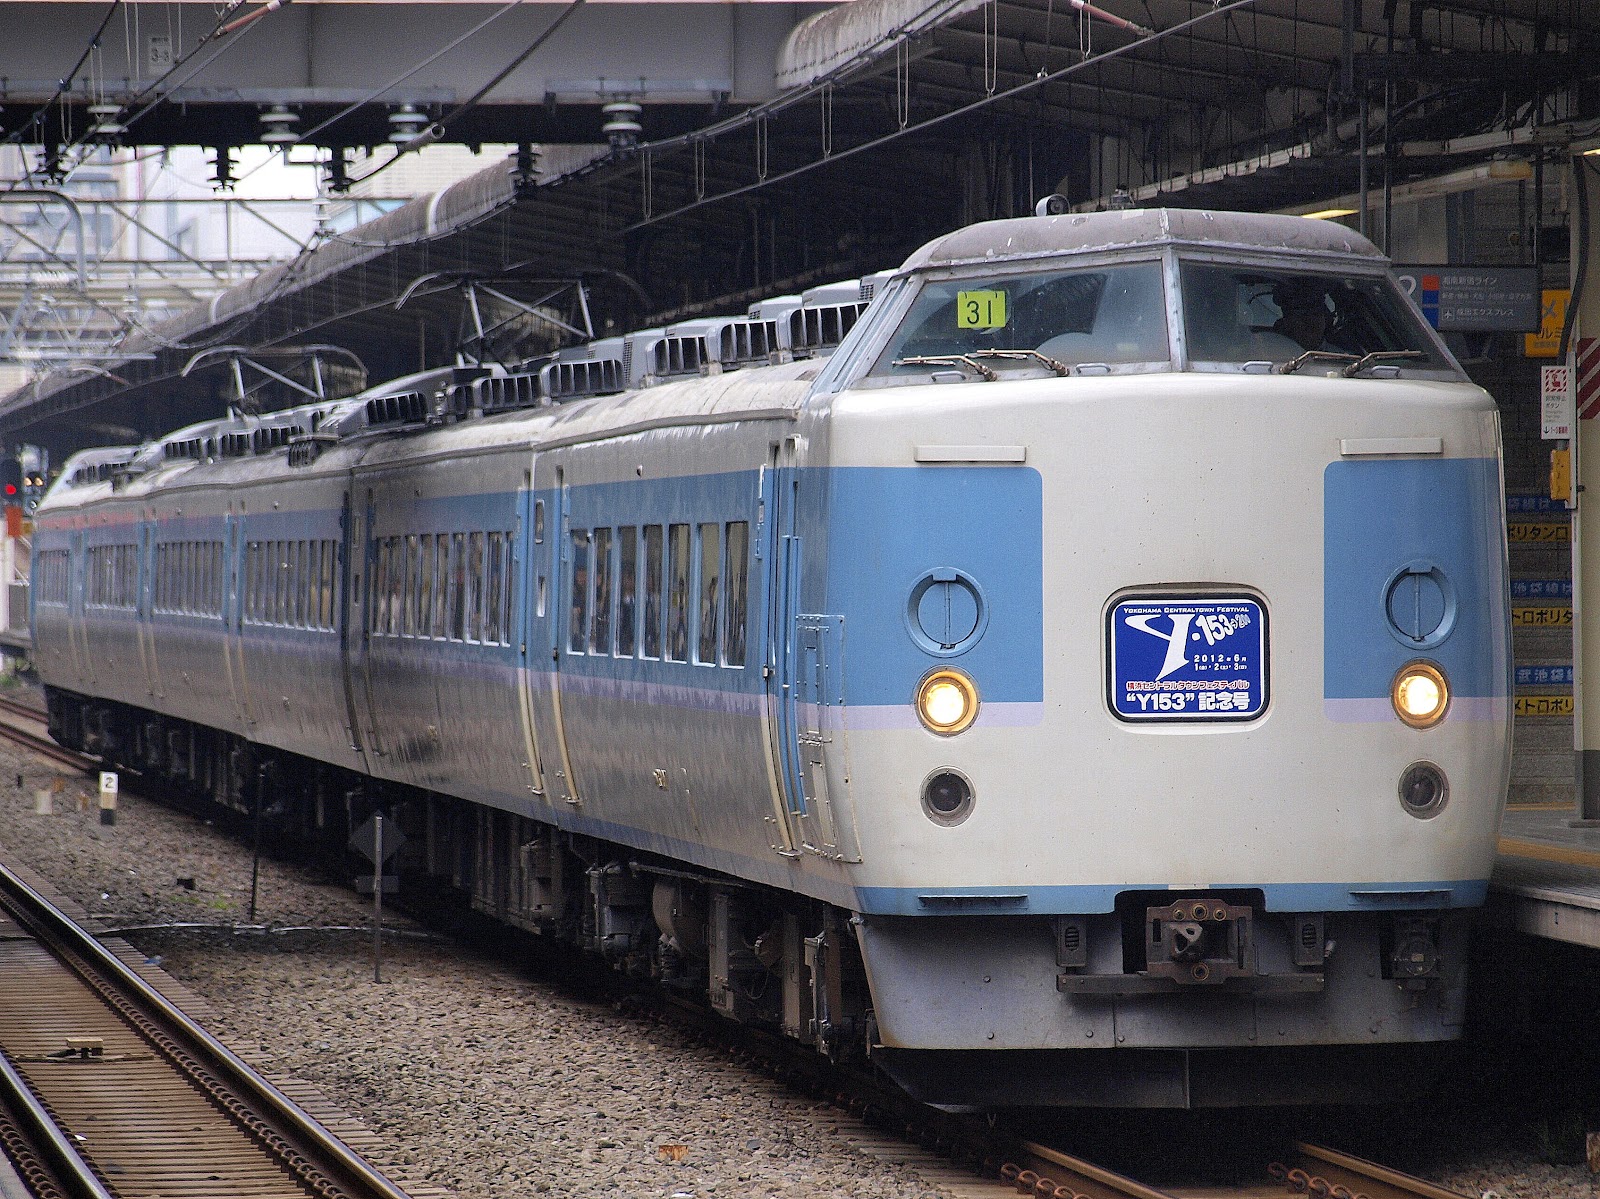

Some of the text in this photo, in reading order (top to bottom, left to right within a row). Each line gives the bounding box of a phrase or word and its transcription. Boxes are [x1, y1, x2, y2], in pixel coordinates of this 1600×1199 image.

[966, 300, 992, 325] 31
[1198, 692, 1251, 711] 記念号
[105, 776, 115, 789] 2
